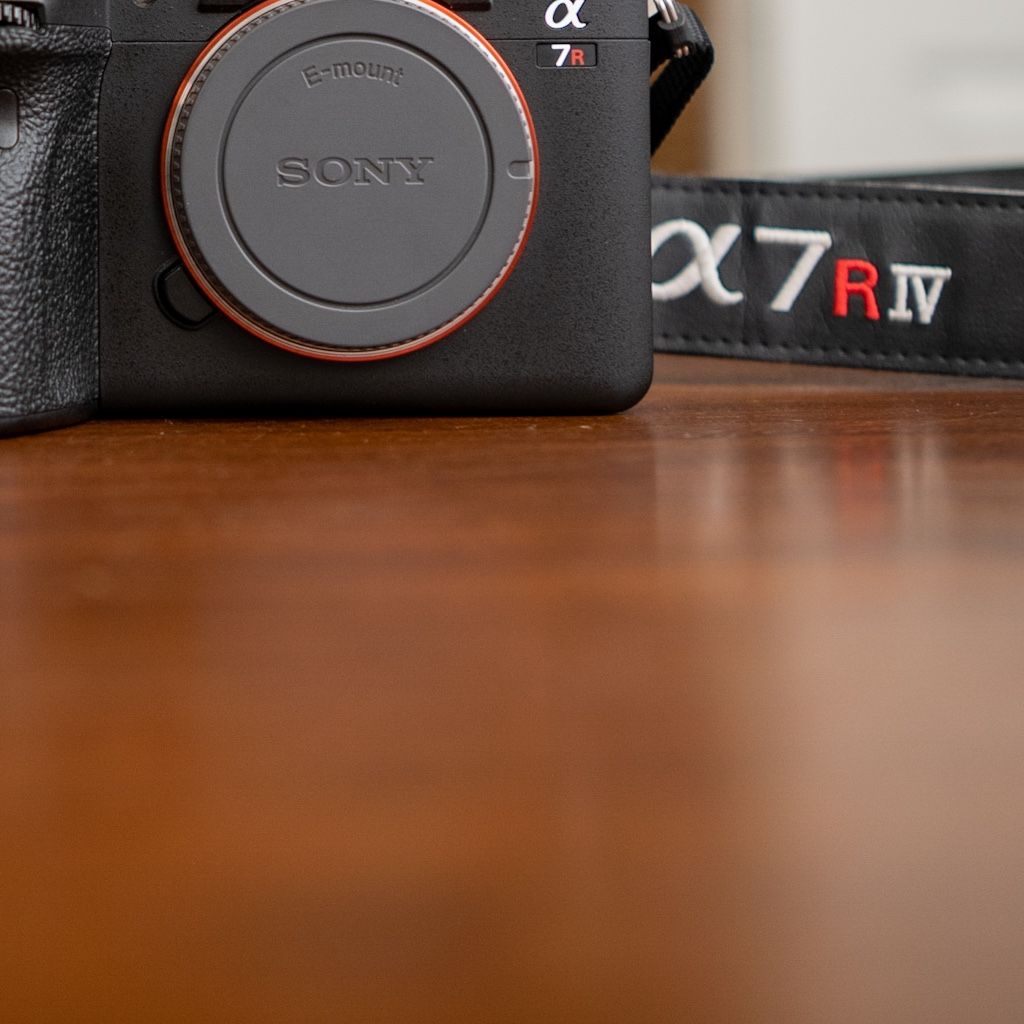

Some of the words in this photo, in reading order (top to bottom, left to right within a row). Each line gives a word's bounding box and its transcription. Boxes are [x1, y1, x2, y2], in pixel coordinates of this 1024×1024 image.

[550, 43, 585, 67] 7R
[301, 60, 405, 89] E-mount
[276, 156, 435, 188] SONY
